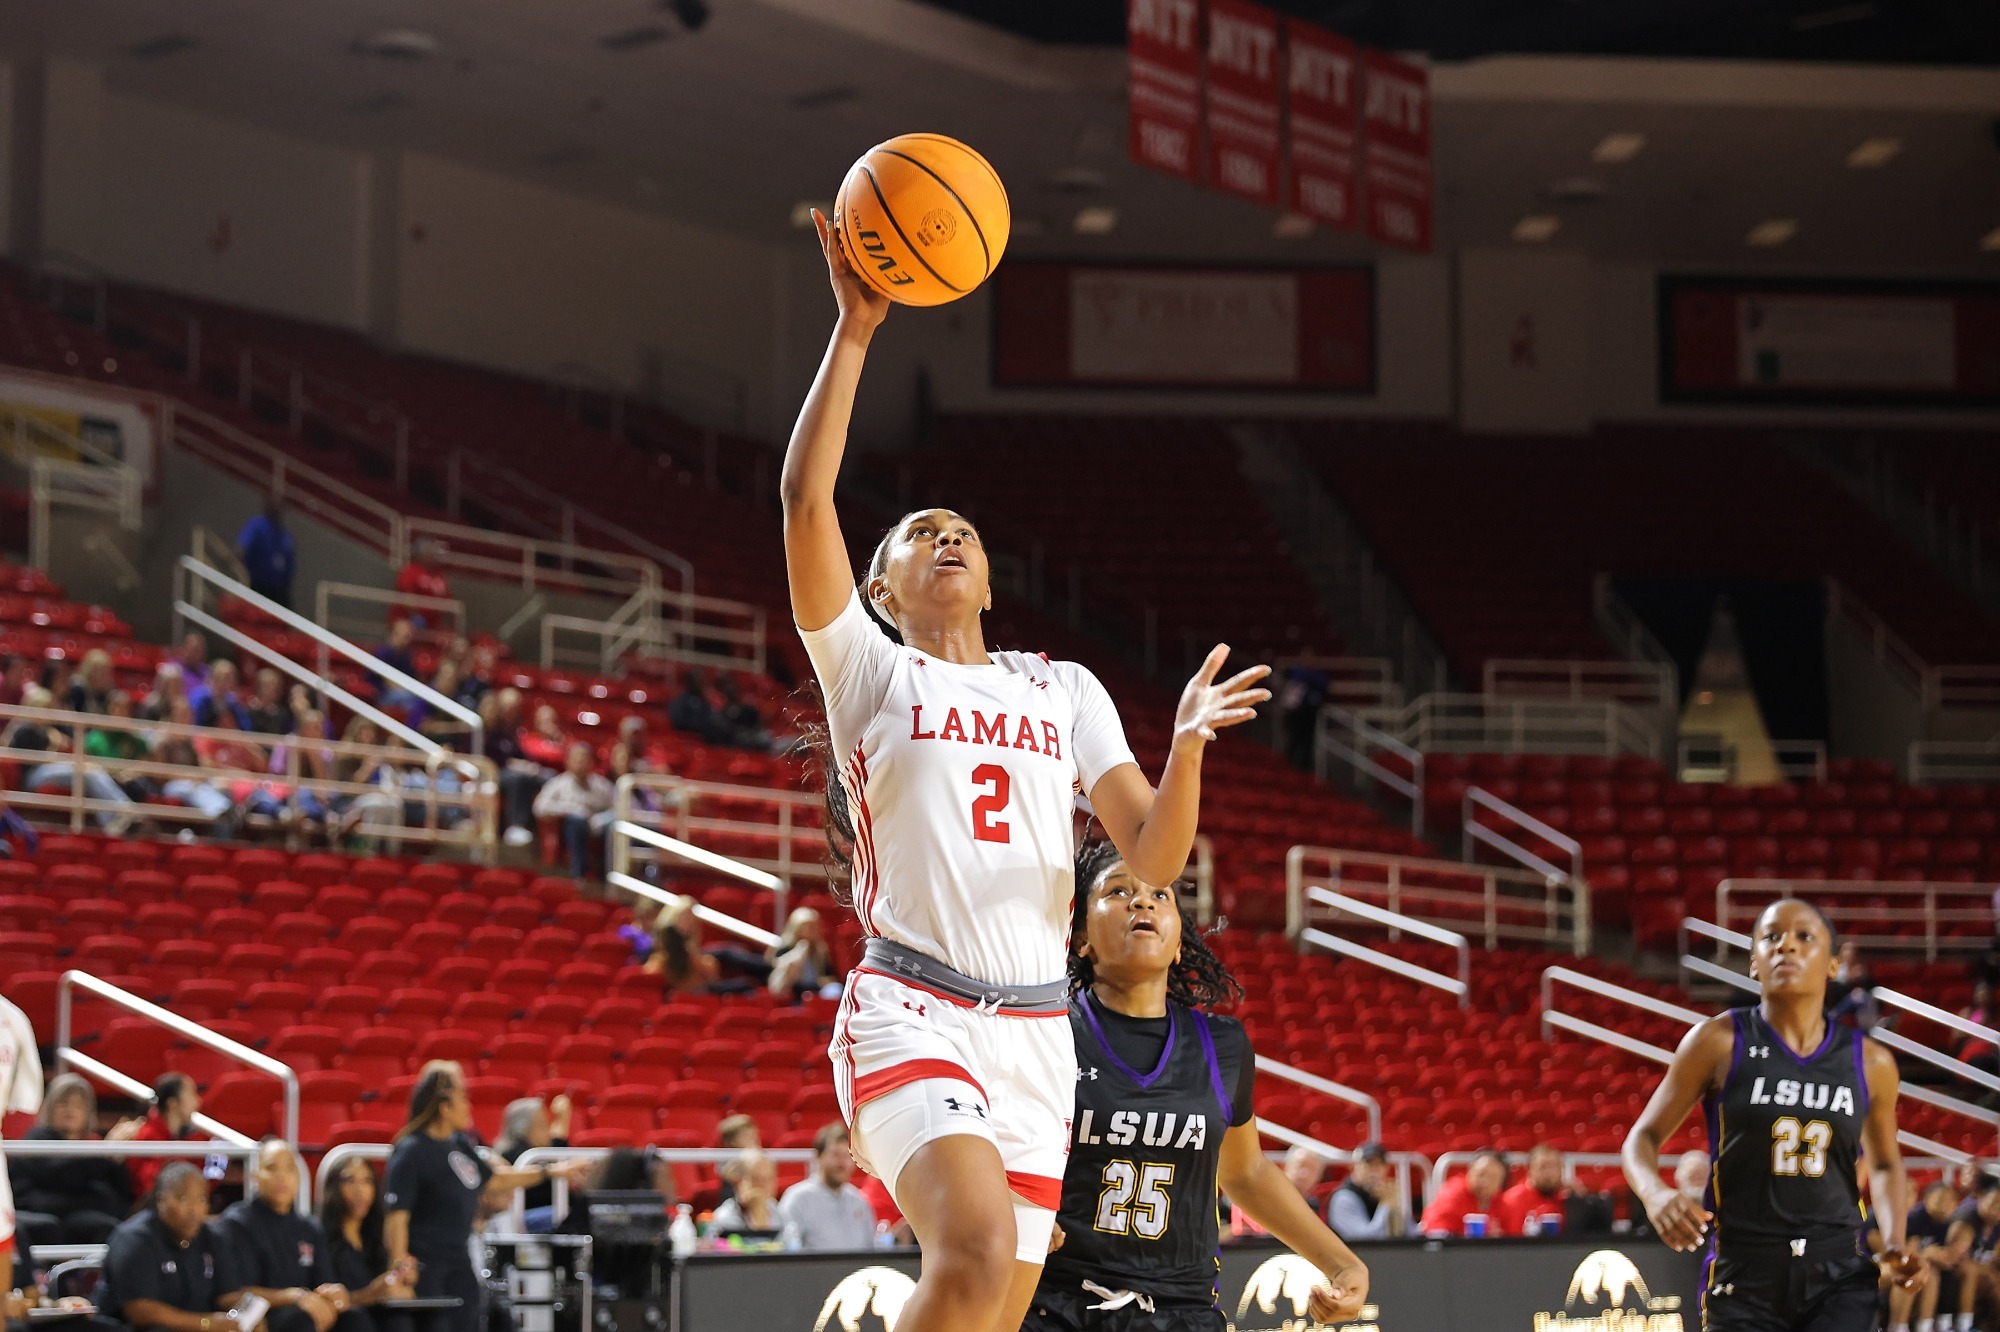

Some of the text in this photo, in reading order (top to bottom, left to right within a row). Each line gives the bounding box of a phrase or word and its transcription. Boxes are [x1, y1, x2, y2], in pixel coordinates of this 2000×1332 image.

[858, 231, 915, 285] EVO
[911, 705, 1062, 761] LAMAR
[972, 763, 1010, 844] 2
[1750, 1076, 1854, 1116] LSUA
[1078, 1109, 1206, 1150] LSUA
[1771, 1116, 1833, 1177] 23
[1093, 1158, 1175, 1240] 25
